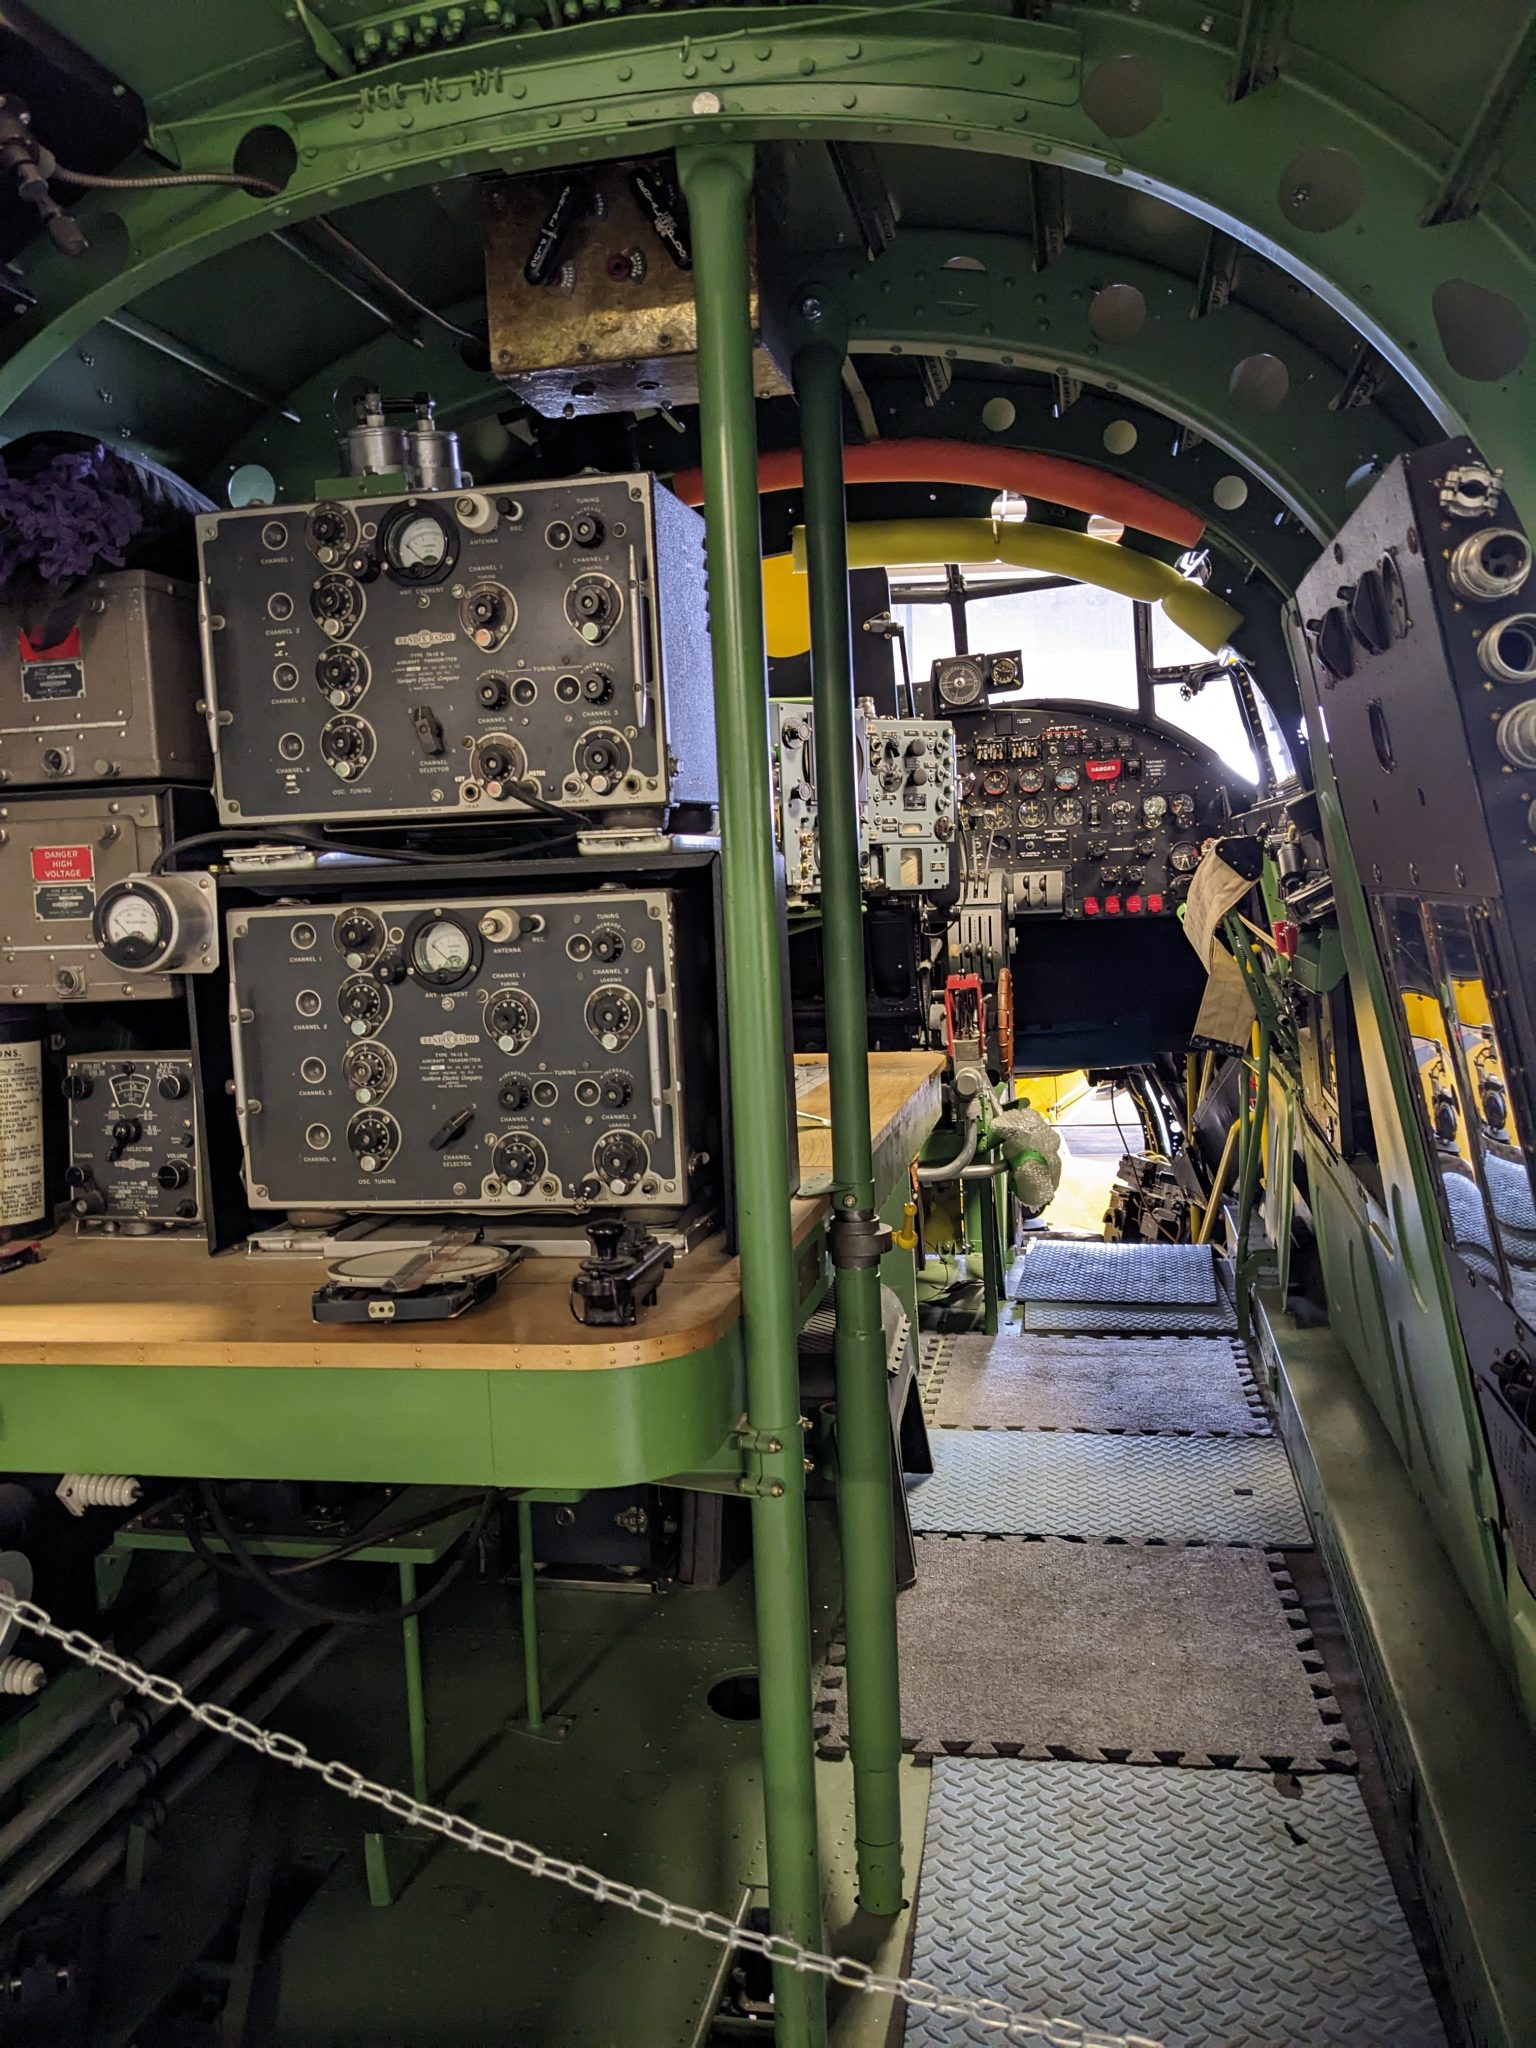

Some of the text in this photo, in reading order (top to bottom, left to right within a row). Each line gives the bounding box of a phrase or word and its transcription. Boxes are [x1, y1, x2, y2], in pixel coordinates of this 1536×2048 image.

[530, 185, 571, 269] AERIAL PLUG
[260, 557, 287, 566] CHANNEL
[572, 556, 603, 564] CHANNEL
[265, 628, 292, 636] CHANNEL
[1090, 765, 1116, 773] DANGER
[45, 850, 78, 859] DANGER
[52, 860, 73, 868] HIGH
[45, 869, 81, 878] VOLTAGE
